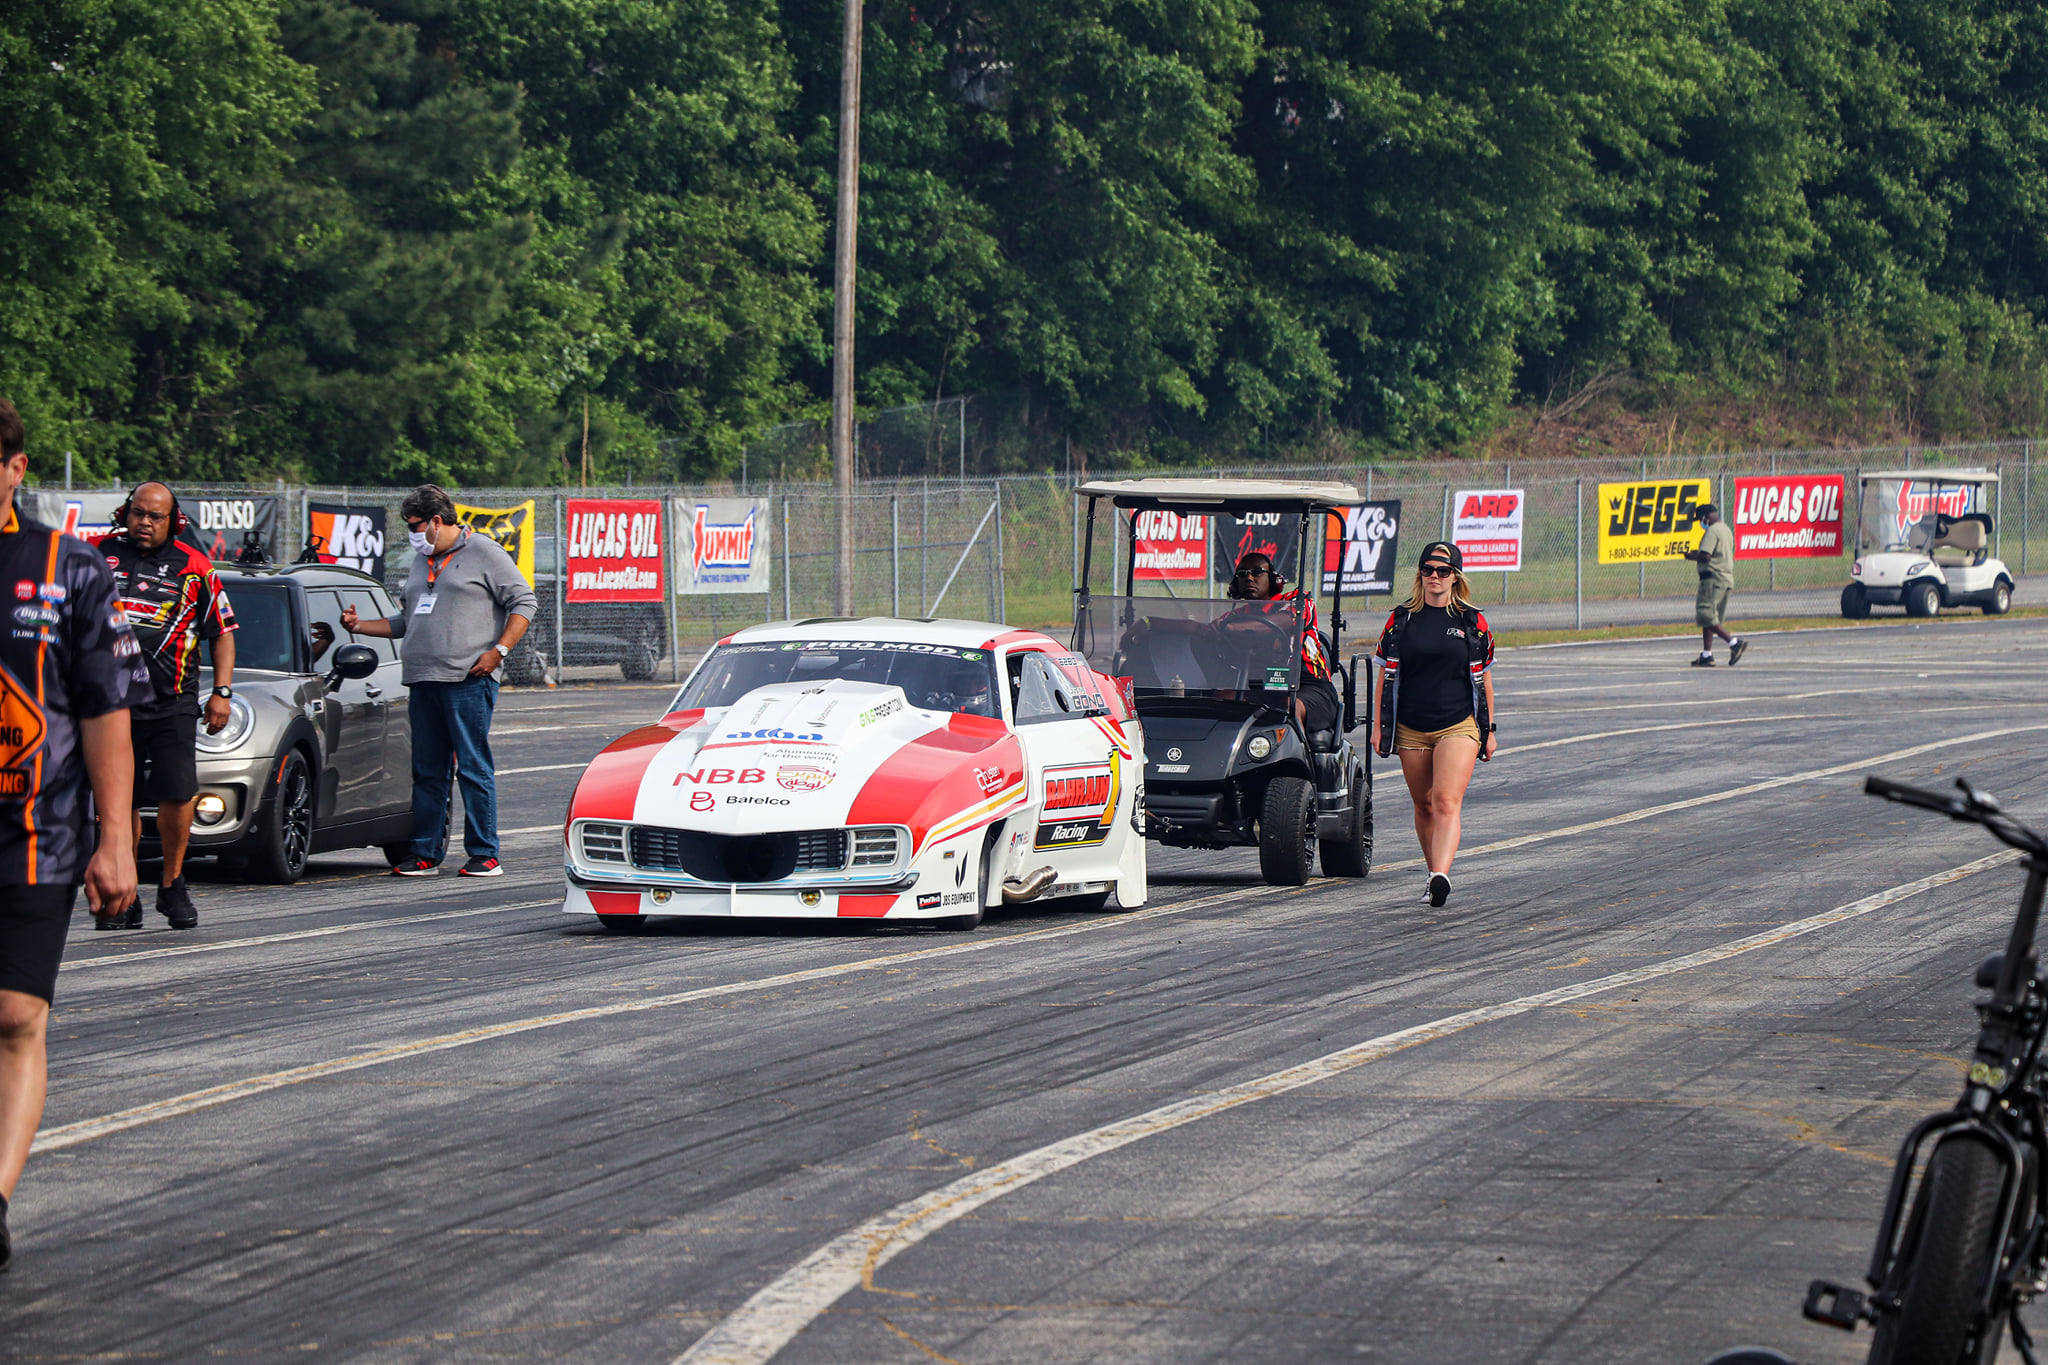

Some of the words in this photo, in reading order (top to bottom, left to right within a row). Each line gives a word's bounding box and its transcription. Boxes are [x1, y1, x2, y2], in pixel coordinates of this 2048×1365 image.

[200, 500, 255, 529] DENSO
[1459, 495, 1518, 518] ARP
[1608, 484, 1700, 536] JEGS
[1736, 485, 1805, 525] LUCAS
[1807, 484, 1840, 522] OIL
[569, 512, 628, 559] LUCAS
[630, 512, 659, 558] OIL
[1740, 528, 1837, 550] www.LucasOil.com
[1134, 549, 1201, 569] www.LucasOil.com
[1608, 545, 1660, 559] 1-800-345-4545
[573, 566, 658, 590] www.LucasOil.com
[806, 641, 876, 649] PRO
[881, 642, 958, 654] MOD
[672, 767, 767, 787] NBB
[726, 795, 791, 806] Batelco
[1044, 775, 1111, 810] BAHRAIN
[1051, 823, 1089, 841] Racing
